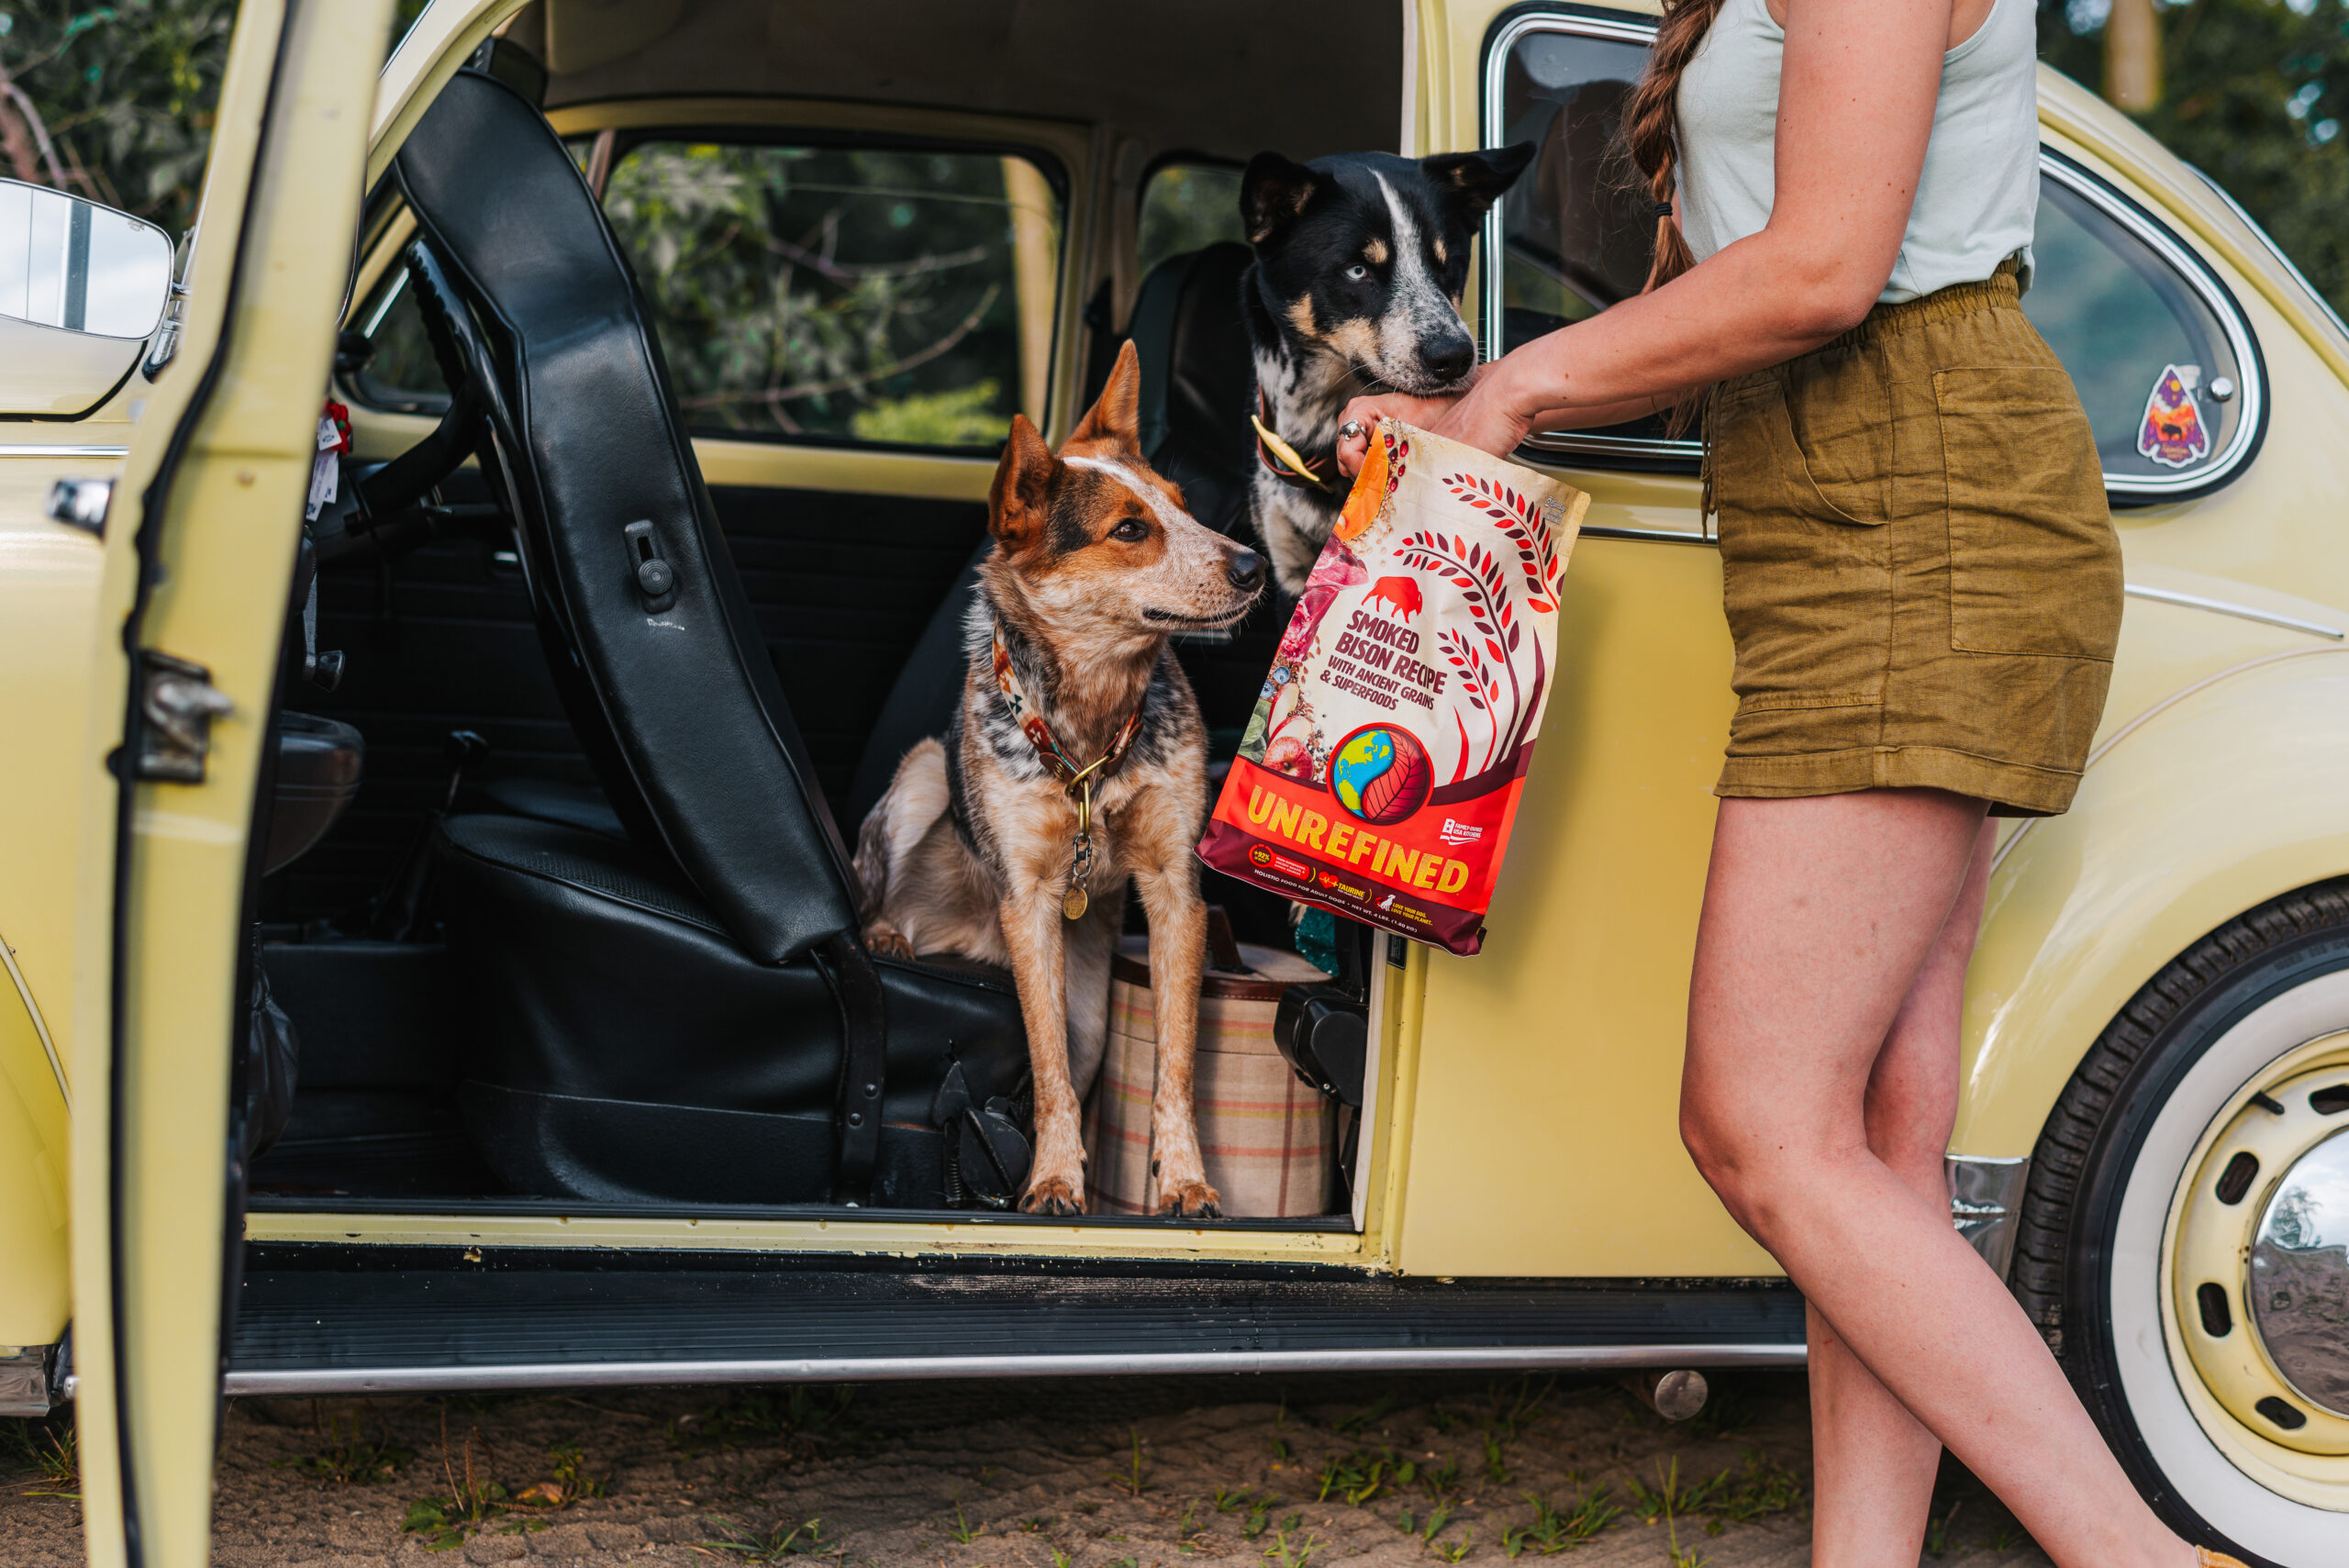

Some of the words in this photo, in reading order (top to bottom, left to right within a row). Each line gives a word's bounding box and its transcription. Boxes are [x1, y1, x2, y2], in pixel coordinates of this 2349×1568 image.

[1347, 610, 1419, 654] SMOKED
[1328, 655, 1356, 676] WITH
[1355, 668, 1401, 694] ANCIENT
[1400, 686, 1434, 710] GRAINS
[1335, 632, 1395, 671] BISON
[1392, 655, 1447, 695] RECIPE
[1319, 670, 1330, 684] &
[1331, 675, 1398, 710] SUPERFOODS
[1248, 784, 1469, 894] UNREFINED
[1254, 869, 1280, 882] HOLISTIC
[1280, 879, 1297, 887] FOOD
[1310, 889, 1329, 898] ADULT
[1328, 895, 1345, 905] DOGS
